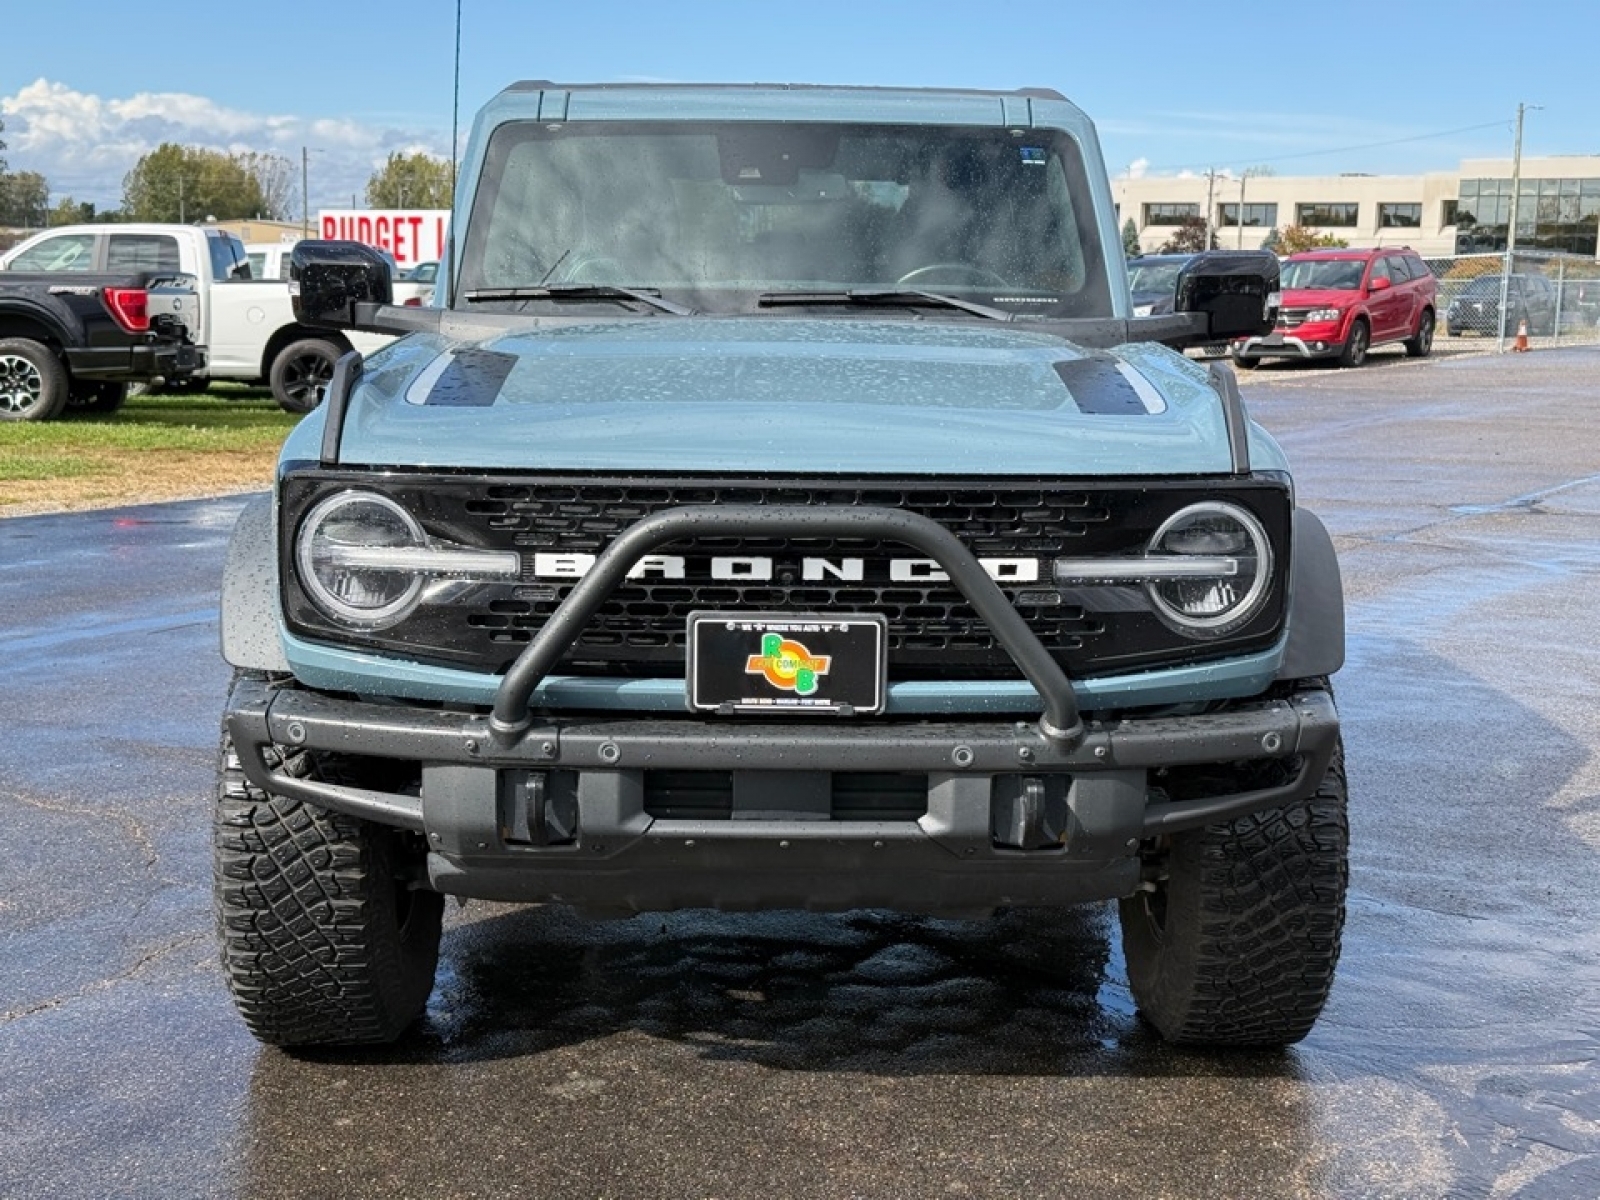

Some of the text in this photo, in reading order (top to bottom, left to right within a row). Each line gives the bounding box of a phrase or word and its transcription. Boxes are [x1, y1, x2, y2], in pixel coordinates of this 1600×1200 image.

[322, 216, 423, 262] BUDGET
[534, 553, 1039, 582] BRONCO
[762, 633, 783, 658] R
[795, 668, 818, 695] B
